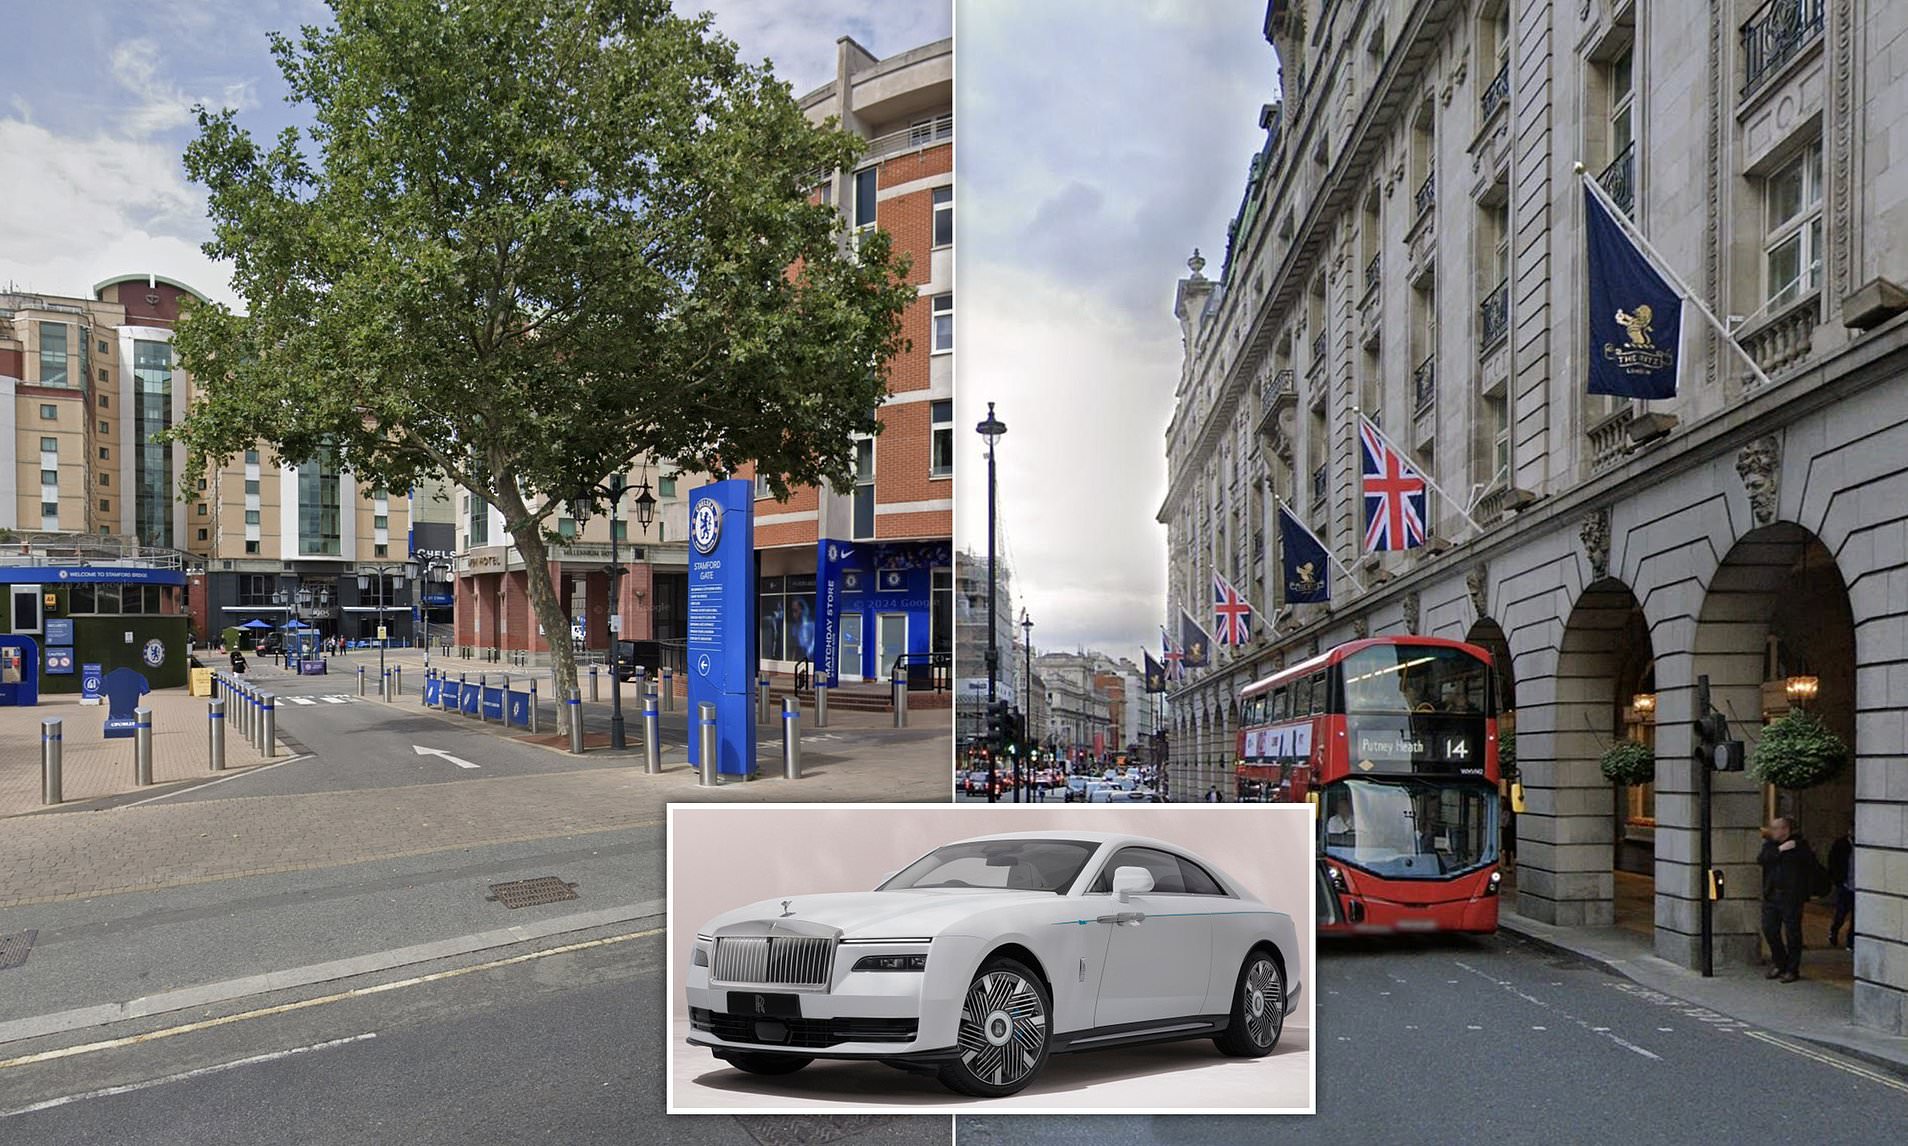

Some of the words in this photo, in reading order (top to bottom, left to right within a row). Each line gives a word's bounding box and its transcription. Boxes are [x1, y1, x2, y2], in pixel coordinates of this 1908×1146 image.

[694, 560, 721, 571] STAMFORD
[699, 571, 715, 580] GATE
[826, 580, 835, 616] STORE
[825, 619, 833, 679] MATCHDAY
[1362, 738, 1393, 756] Putney
[1395, 738, 1424, 752] Heath
[1446, 739, 1469, 758] 14
